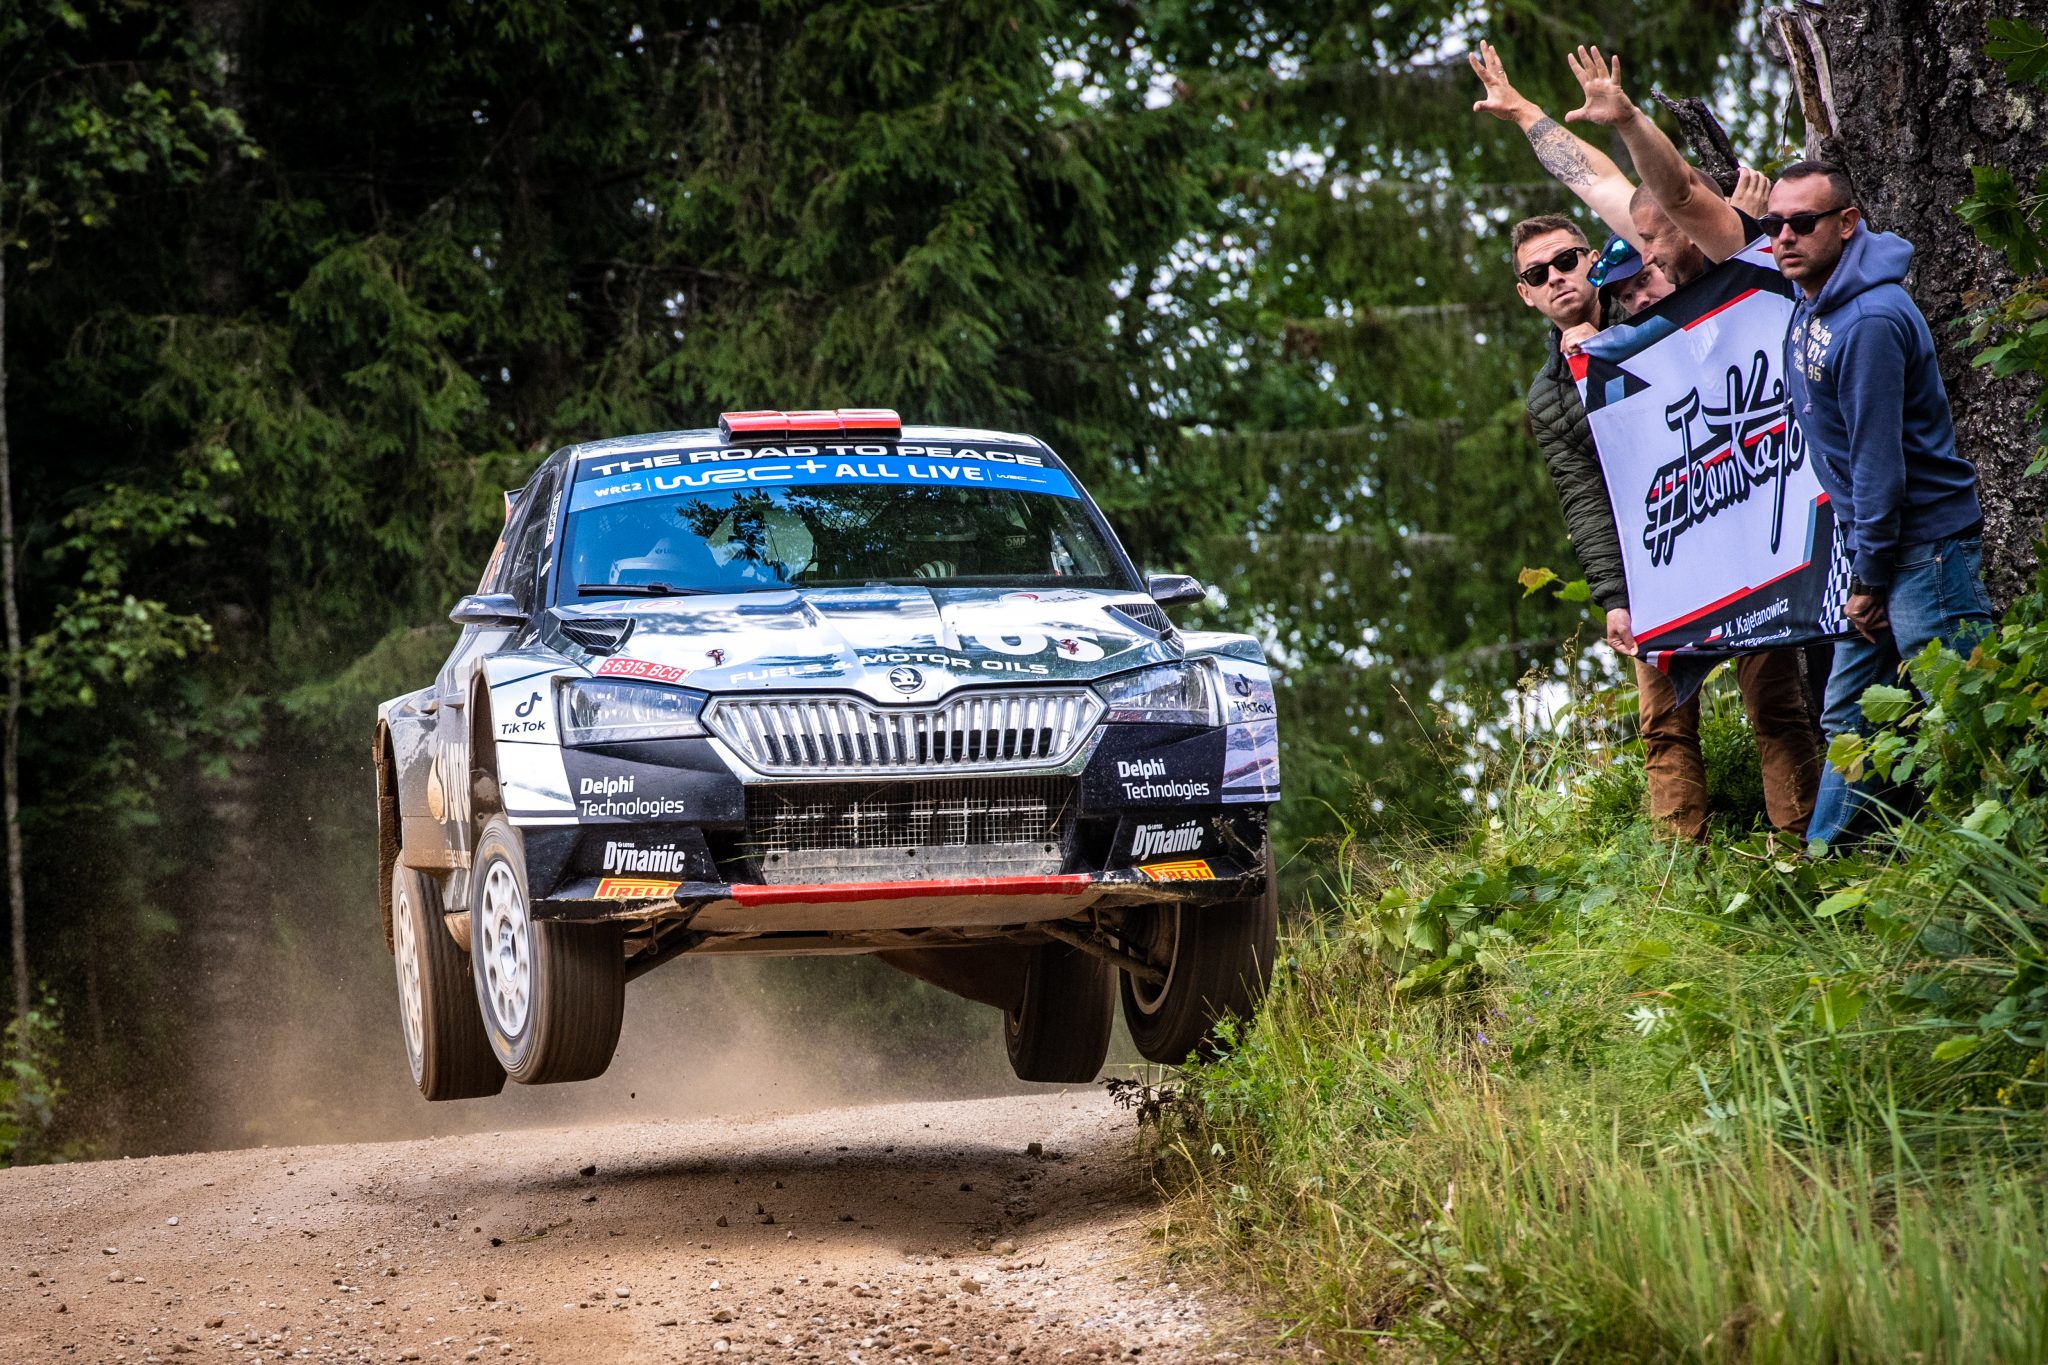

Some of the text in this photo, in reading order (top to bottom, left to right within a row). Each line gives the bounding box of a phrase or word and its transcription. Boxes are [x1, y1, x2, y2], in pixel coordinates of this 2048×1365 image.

[592, 445, 1044, 476] THE ROAD TO PEACE
[594, 482, 643, 498] WRC2
[835, 463, 900, 478] ALL
[908, 464, 985, 481] LIVE
[1005, 537, 1026, 547] OMP
[1735, 598, 1789, 635] Kajetanowicz
[600, 660, 683, 679] S6315 BCG
[730, 653, 1049, 684] FUELS & MOTOR OILS
[1117, 759, 1166, 779] Delphi
[580, 776, 635, 797] Delphi
[1122, 780, 1210, 800] Technologies
[580, 797, 685, 818] Technologies
[1131, 820, 1204, 861] Dynamic
[603, 841, 686, 875] Dynamic
[596, 879, 680, 897] PIRELLI
